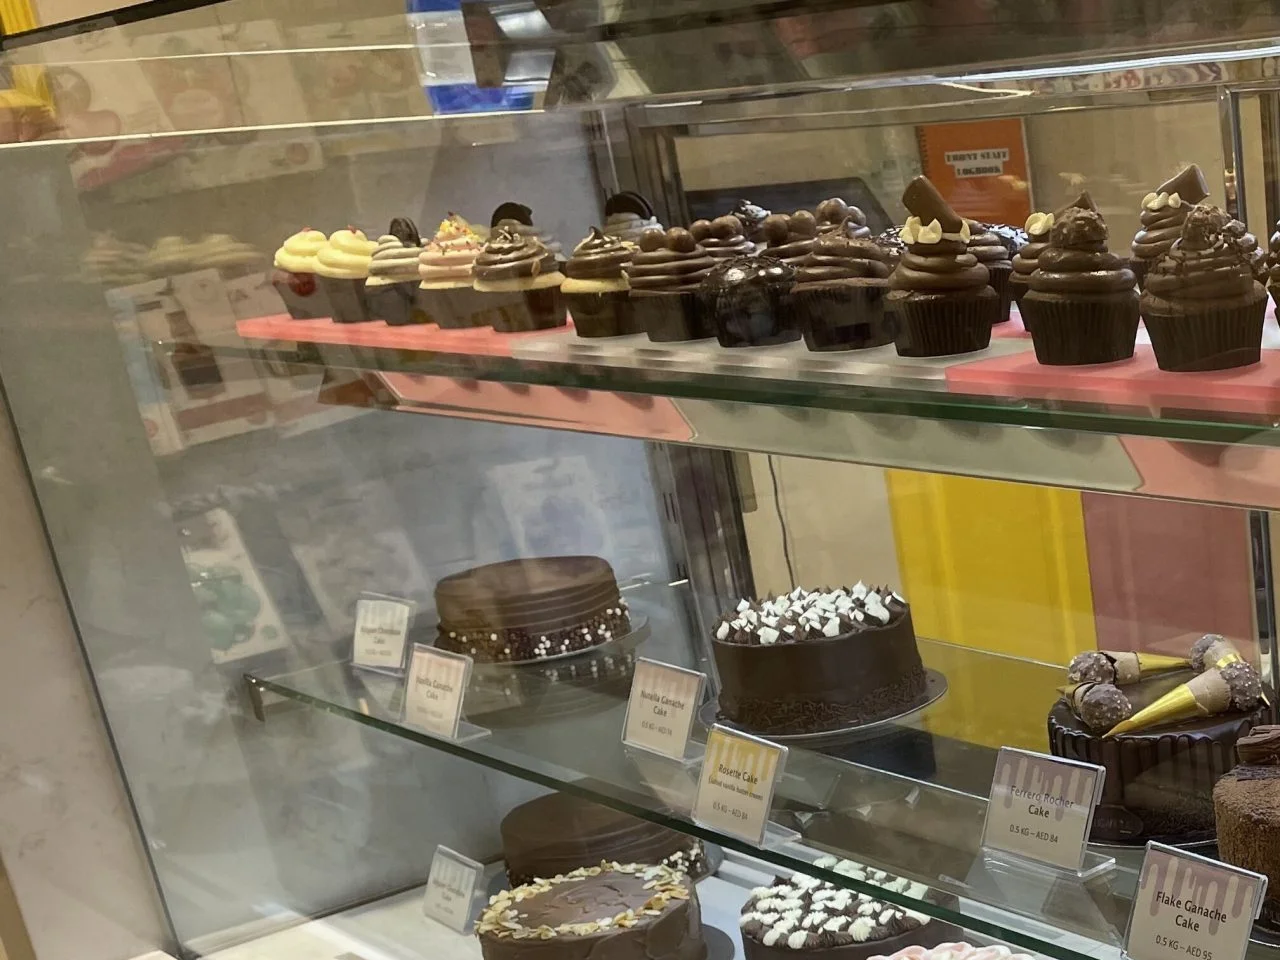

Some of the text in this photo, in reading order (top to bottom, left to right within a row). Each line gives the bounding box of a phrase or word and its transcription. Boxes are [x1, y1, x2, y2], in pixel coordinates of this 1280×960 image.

[653, 706, 667, 717] Cake
[718, 764, 758, 784] Rosette Cake
[1010, 785, 1075, 808] Ferrero Rocher
[1028, 804, 1050, 818] Cake
[1009, 824, 1019, 834] 0.5
[1021, 828, 1029, 836] KG
[1036, 831, 1048, 841] AED
[1049, 834, 1058, 843] 84
[1156, 891, 1227, 923] Flake Ganache
[1175, 915, 1200, 932] Cake
[1156, 935, 1167, 946] 0.5
[1168, 940, 1179, 950] KG
[1186, 945, 1201, 958] AED
[1203, 950, 1212, 960] 95
